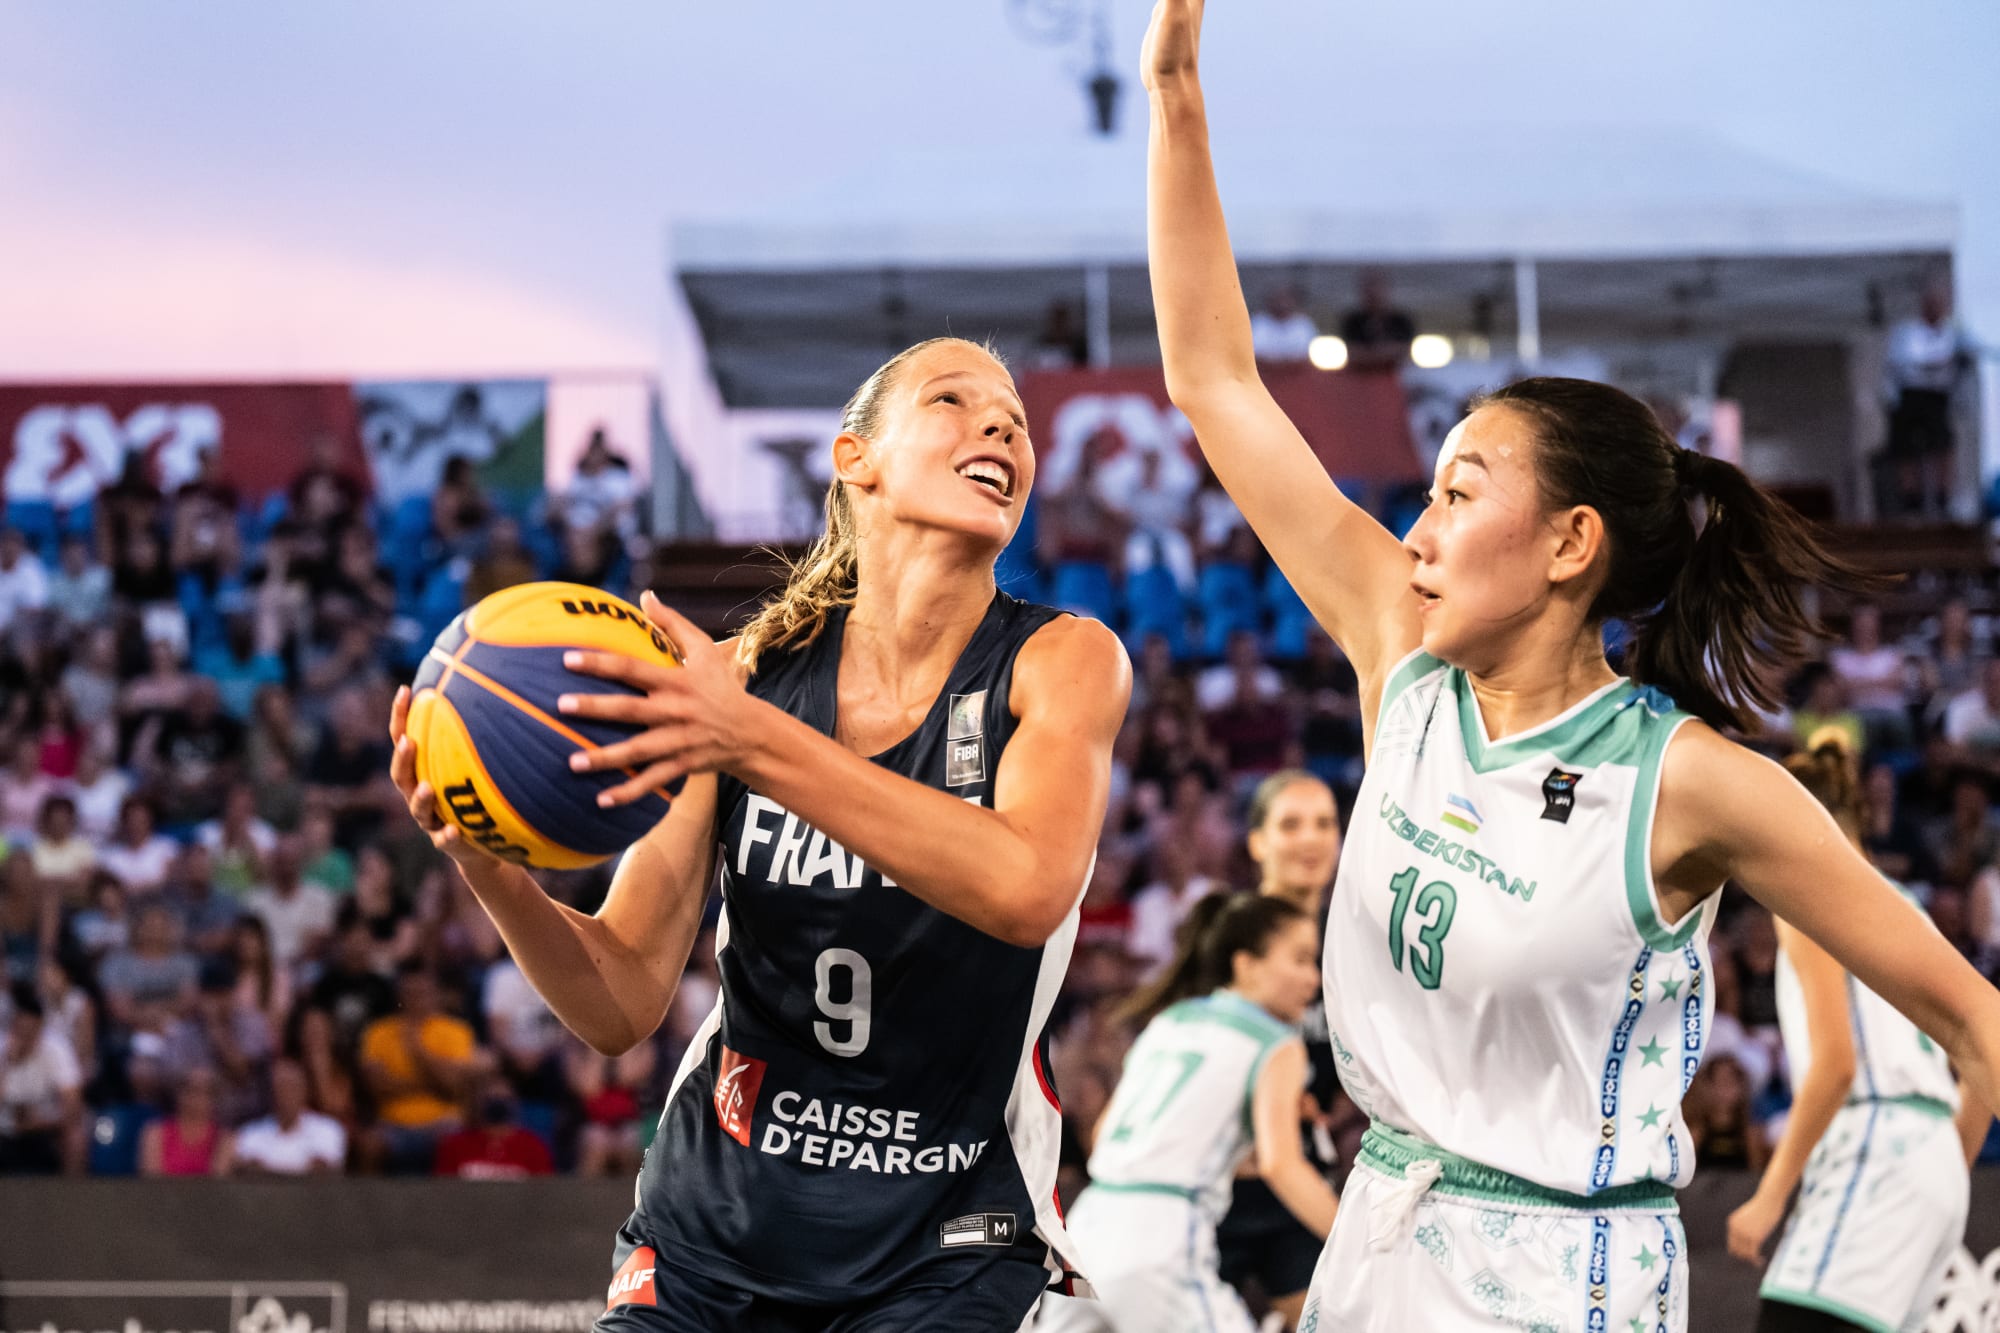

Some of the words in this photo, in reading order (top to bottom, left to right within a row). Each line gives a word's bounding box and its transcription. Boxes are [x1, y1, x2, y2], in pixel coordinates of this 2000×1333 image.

[954, 744, 979, 762] FIBA
[737, 793, 982, 888] FRA
[1380, 792, 1538, 902] UZBEKISTAN
[1389, 866, 1458, 990] 13
[813, 948, 872, 1058] 9
[771, 1091, 920, 1142] CAISSE
[994, 1222, 1008, 1236] M
